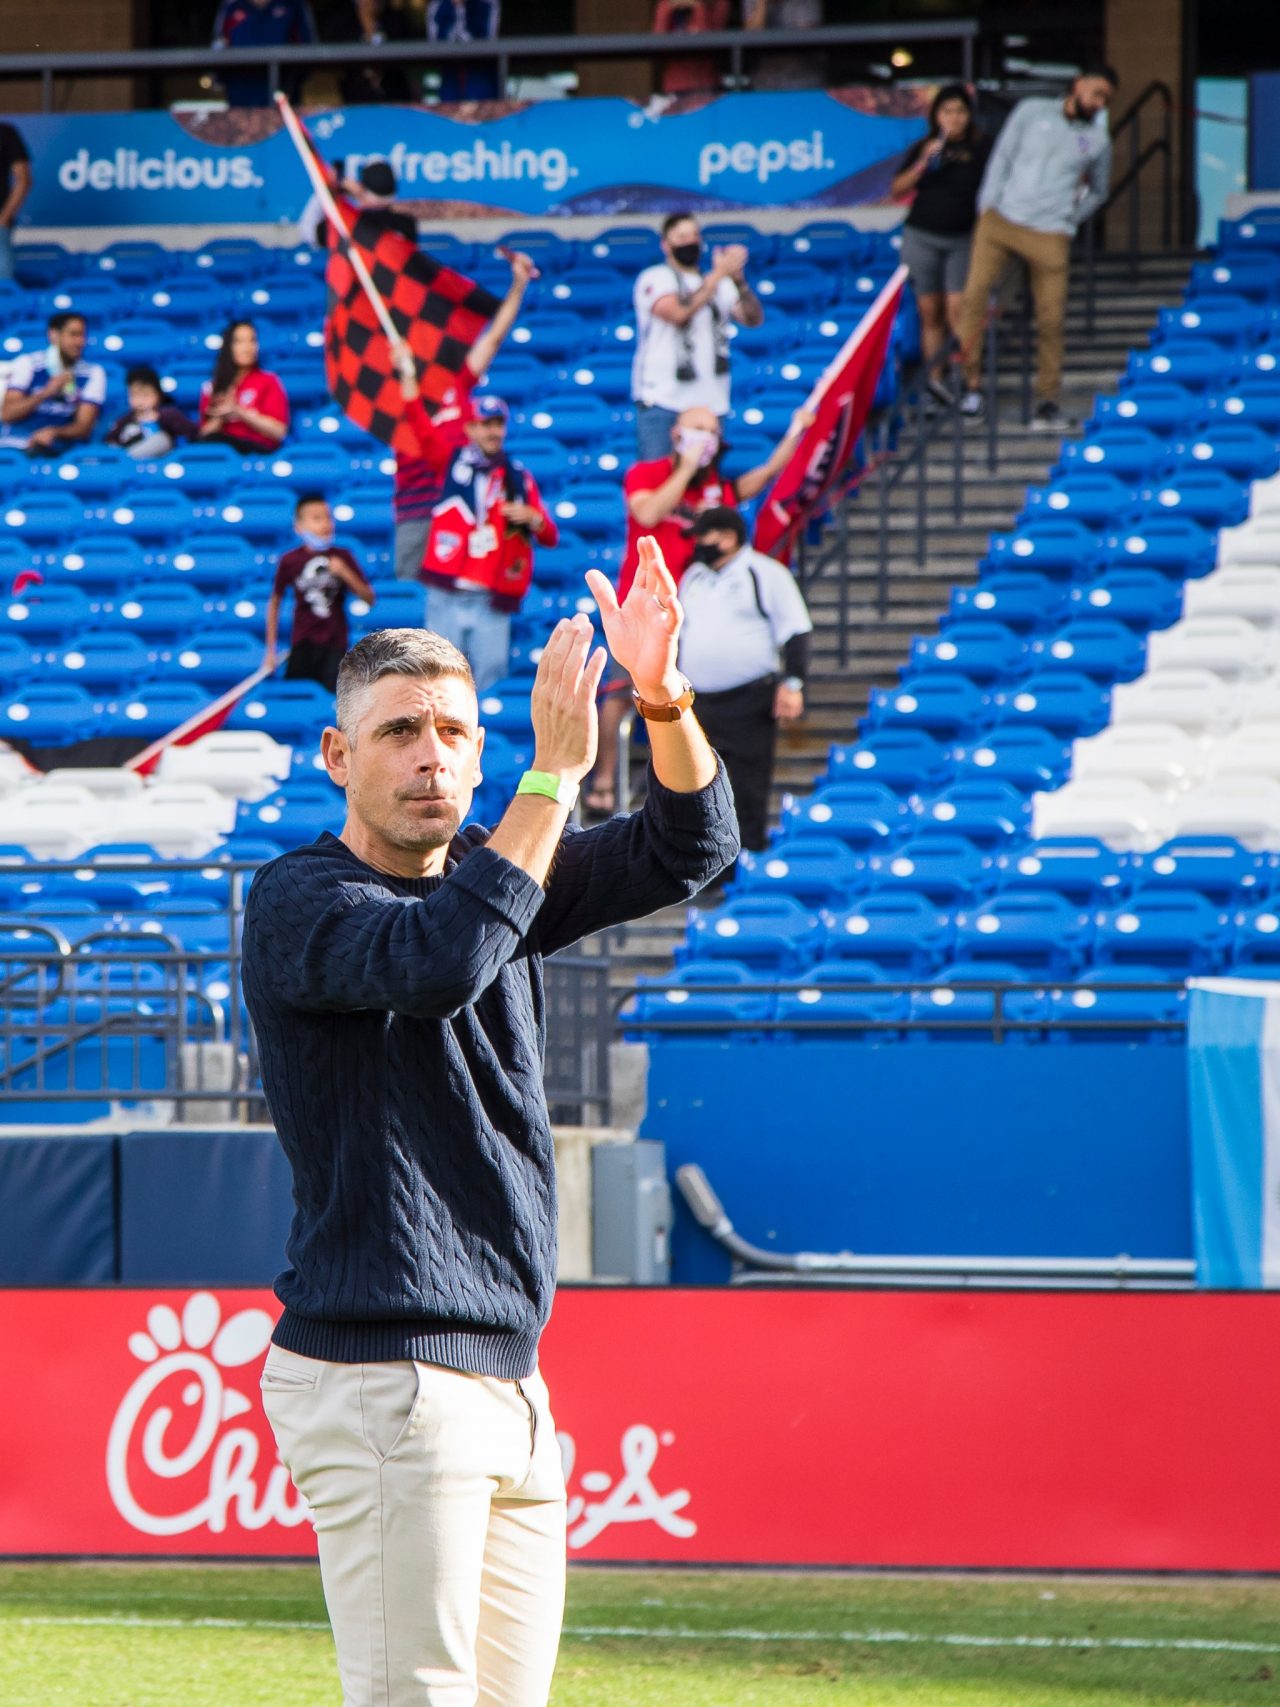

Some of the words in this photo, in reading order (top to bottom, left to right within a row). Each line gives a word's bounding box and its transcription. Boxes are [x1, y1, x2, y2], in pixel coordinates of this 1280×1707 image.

[58, 148, 264, 193] delicious.
[344, 138, 579, 192] rfreshing.
[699, 129, 835, 186] pepsi.
